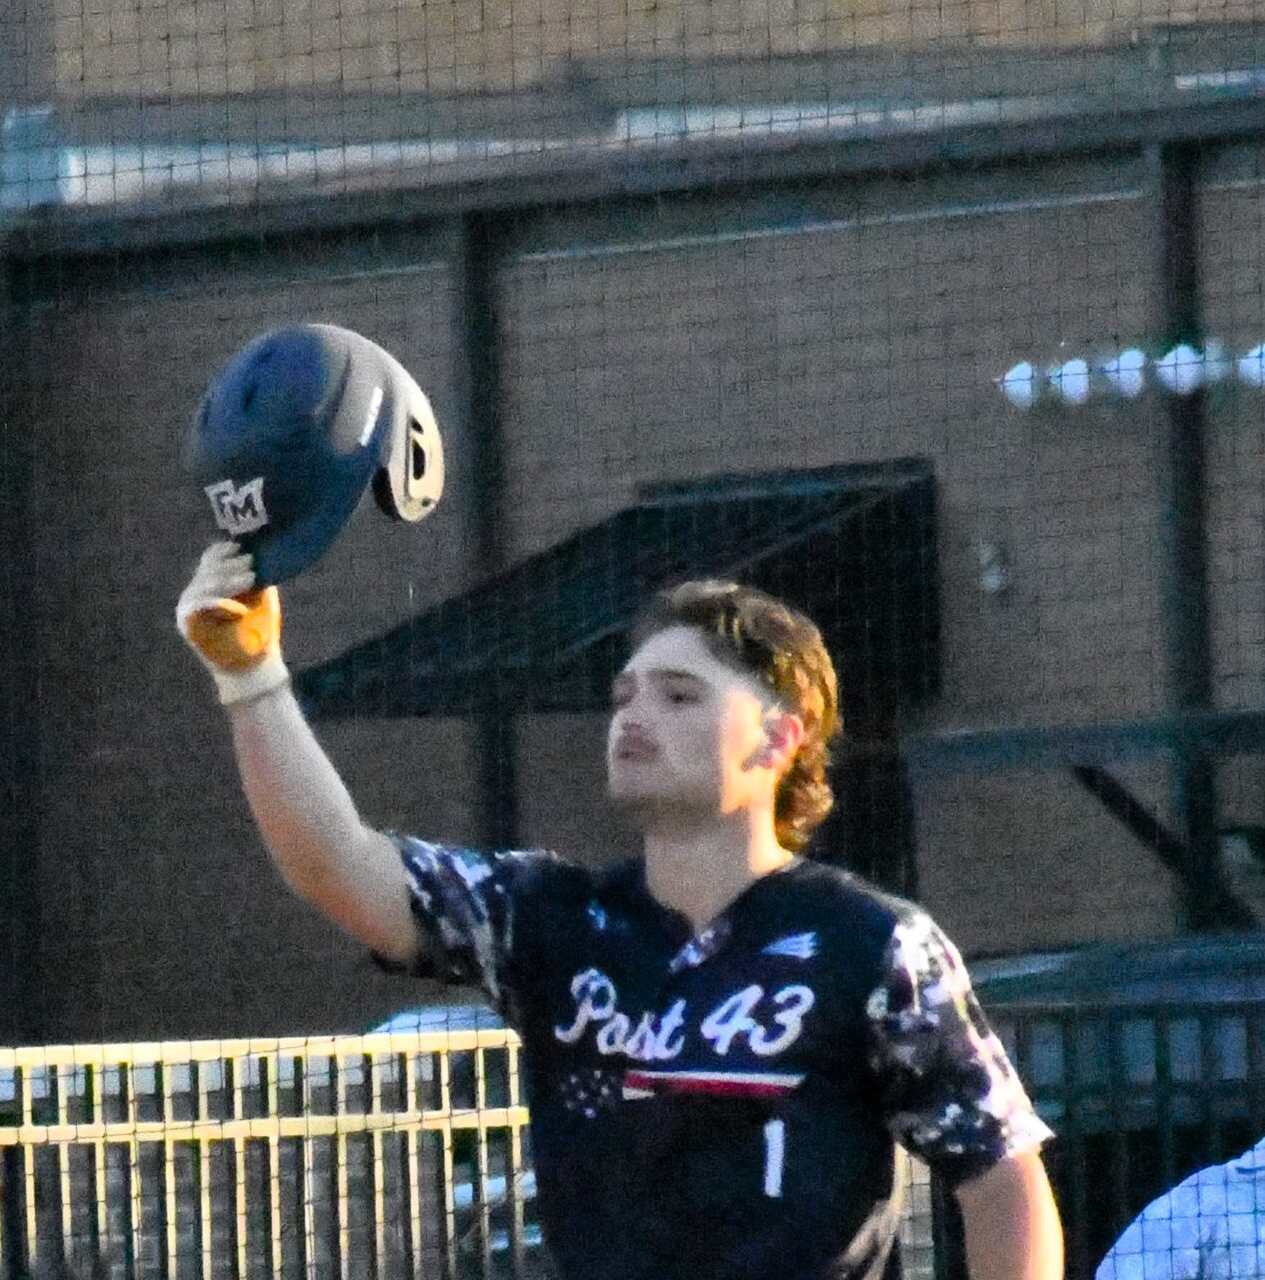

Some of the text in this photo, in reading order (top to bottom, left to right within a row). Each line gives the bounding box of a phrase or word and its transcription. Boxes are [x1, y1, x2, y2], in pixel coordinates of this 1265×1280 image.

[554, 967, 817, 1061] Post 43
[763, 1119, 786, 1198] 1
